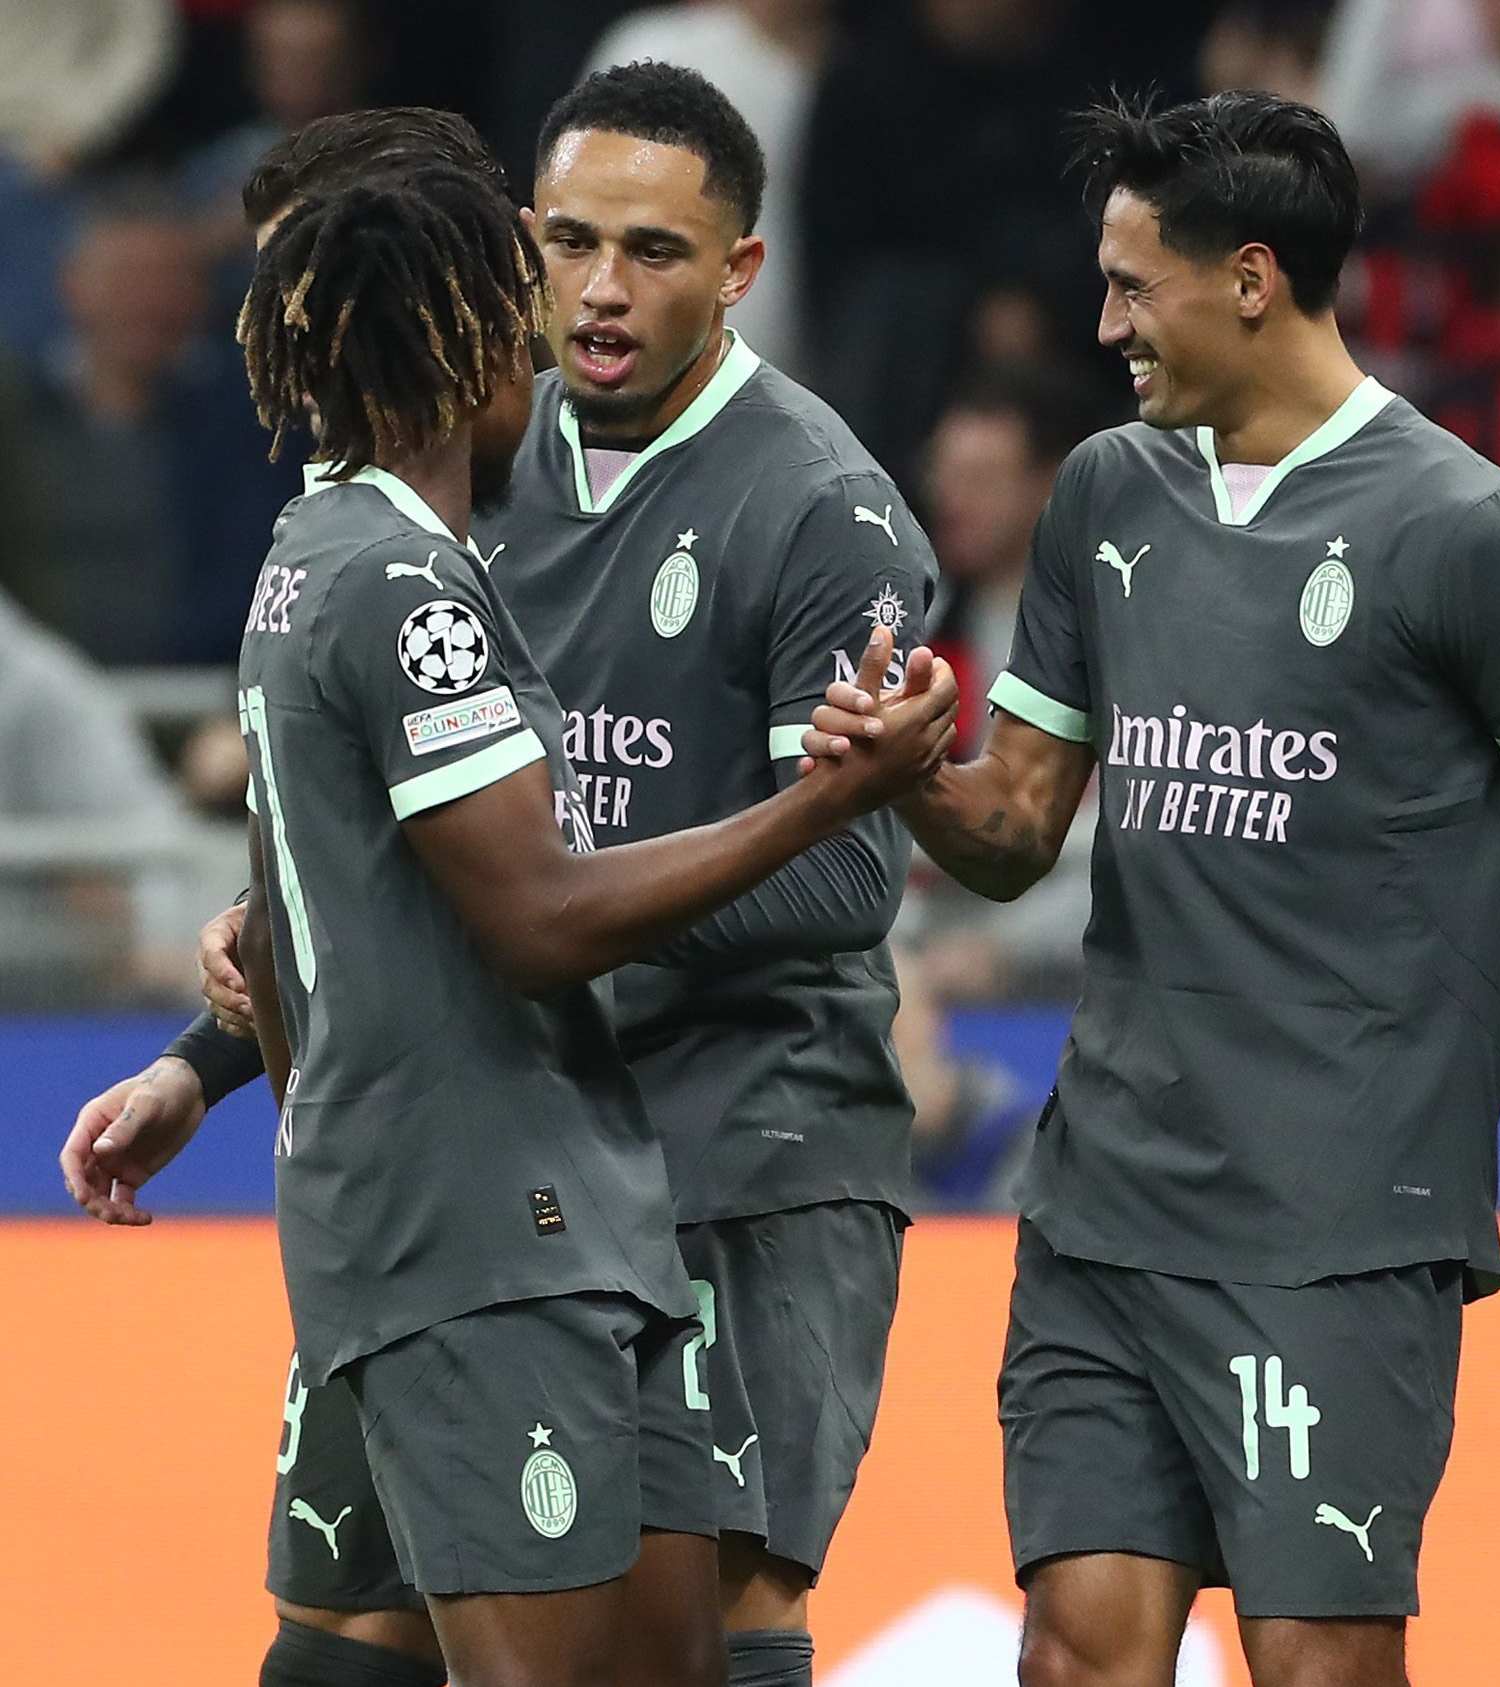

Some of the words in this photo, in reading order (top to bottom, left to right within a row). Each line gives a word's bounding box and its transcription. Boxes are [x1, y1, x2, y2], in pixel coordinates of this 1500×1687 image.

[409, 698, 513, 742] FOUNDATION
[561, 703, 674, 769] ates
[1157, 781, 1293, 843] BETTER
[1228, 1353, 1322, 1482] 14
